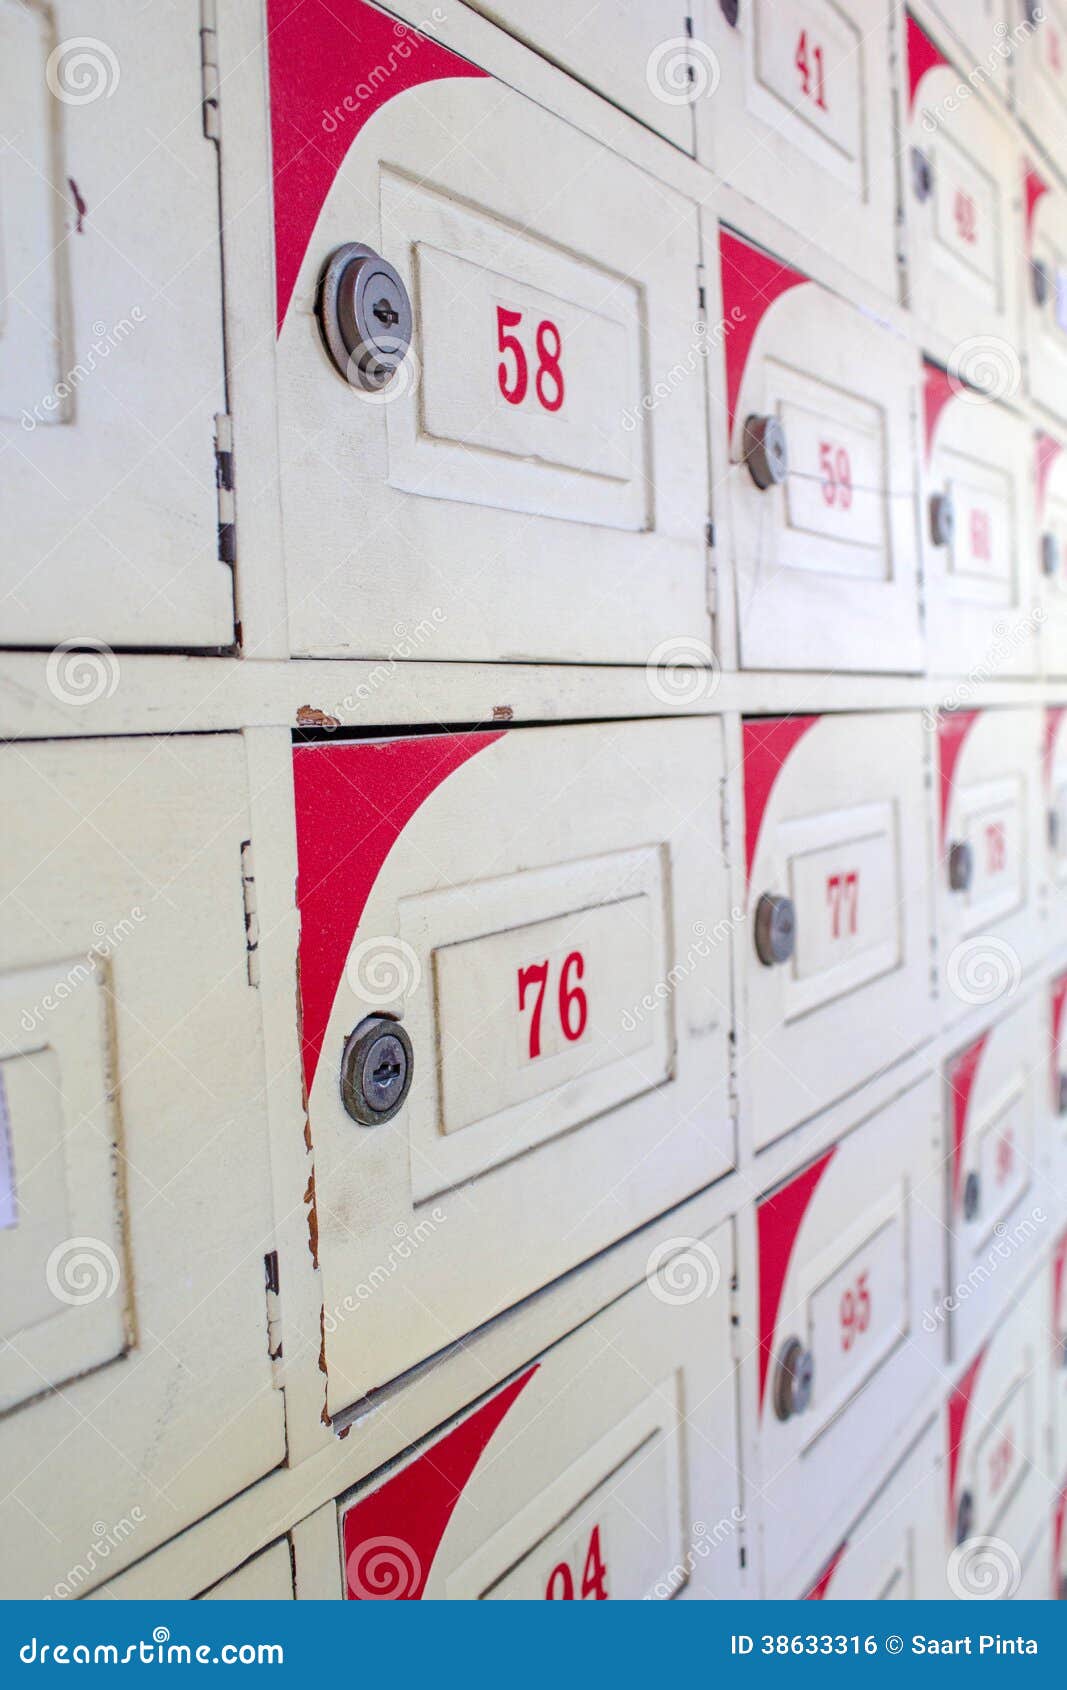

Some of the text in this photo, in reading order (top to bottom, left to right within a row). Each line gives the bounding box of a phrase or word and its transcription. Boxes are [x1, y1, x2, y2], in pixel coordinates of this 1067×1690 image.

[796, 29, 828, 112] 41
[496, 305, 564, 412] 58
[819, 441, 853, 511] 59
[827, 871, 859, 939] 77
[517, 951, 588, 1059] 76
[840, 1267, 871, 1351] 95
